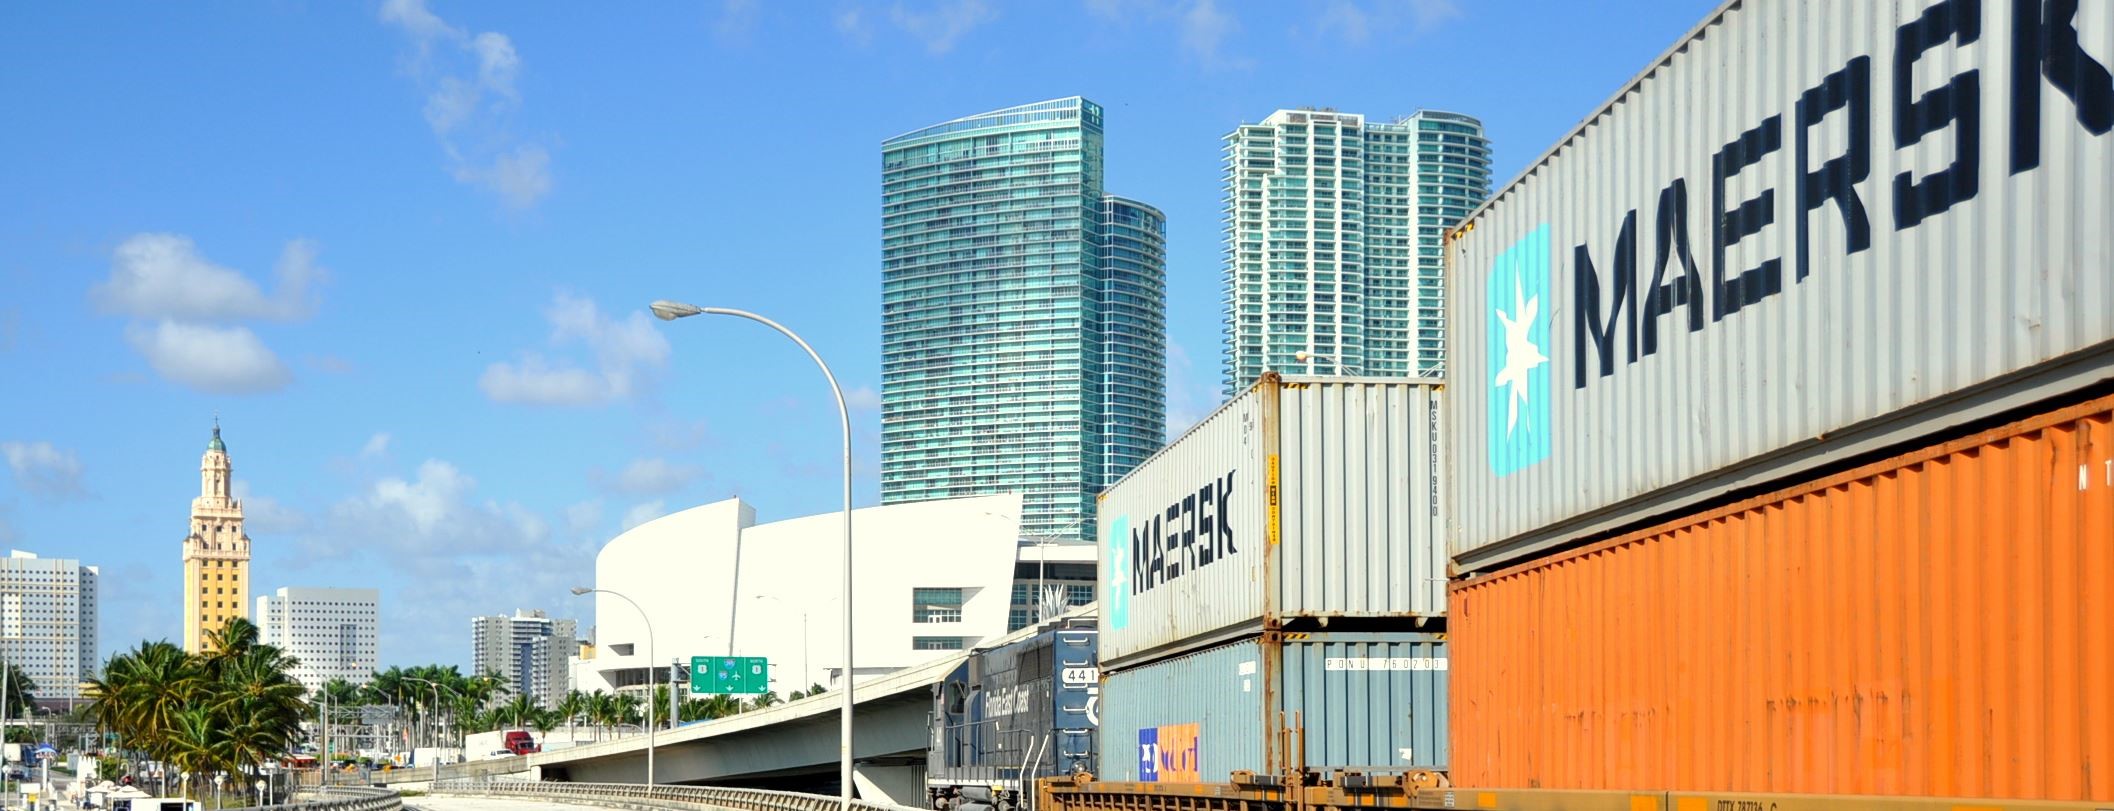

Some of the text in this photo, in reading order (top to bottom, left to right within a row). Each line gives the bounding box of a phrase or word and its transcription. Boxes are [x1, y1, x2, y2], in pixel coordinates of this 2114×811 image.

[1575, 0, 2114, 390] MAERSK
[1133, 469, 1237, 596] MAERSK
[1068, 669, 1095, 681] 441
[1327, 659, 1366, 669] PONU
[985, 684, 1030, 719] Florida East Coast
